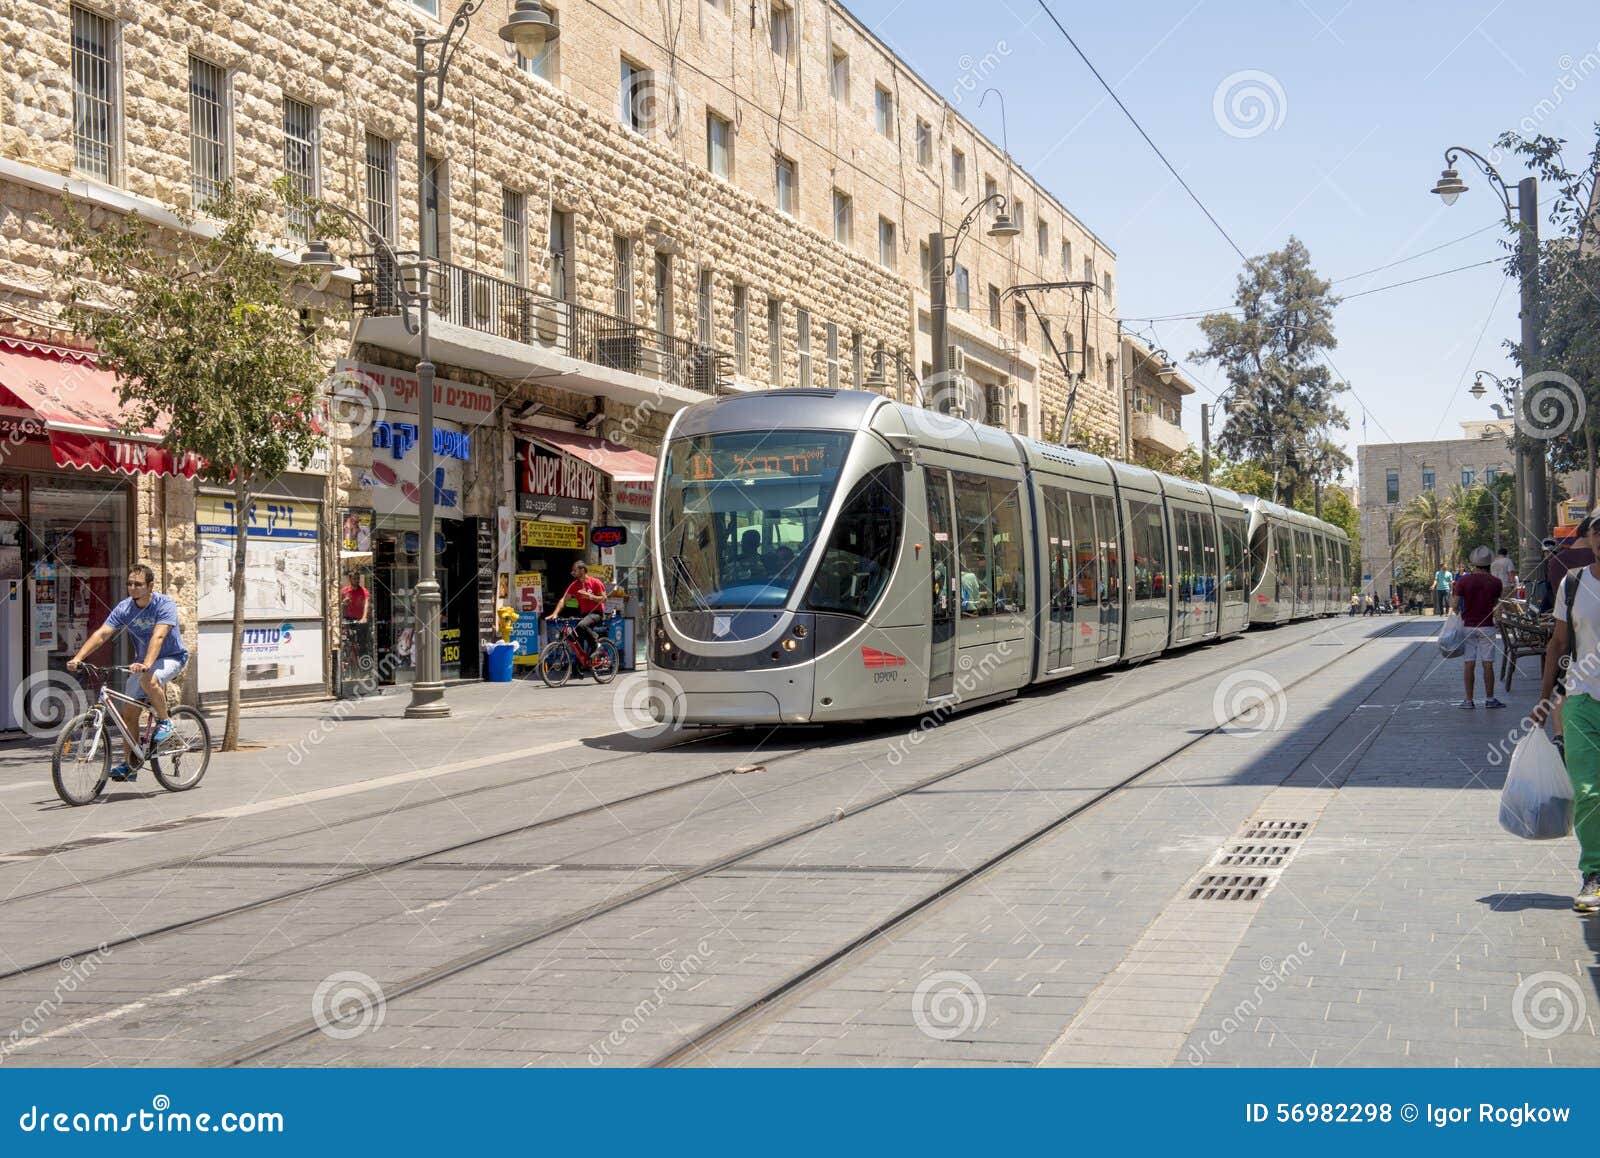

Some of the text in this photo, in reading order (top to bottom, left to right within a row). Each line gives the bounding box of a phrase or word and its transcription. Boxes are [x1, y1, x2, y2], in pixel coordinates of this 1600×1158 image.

[528, 443, 595, 500] Super Marke
[521, 588, 537, 611] 5
[444, 645, 461, 662] 150
